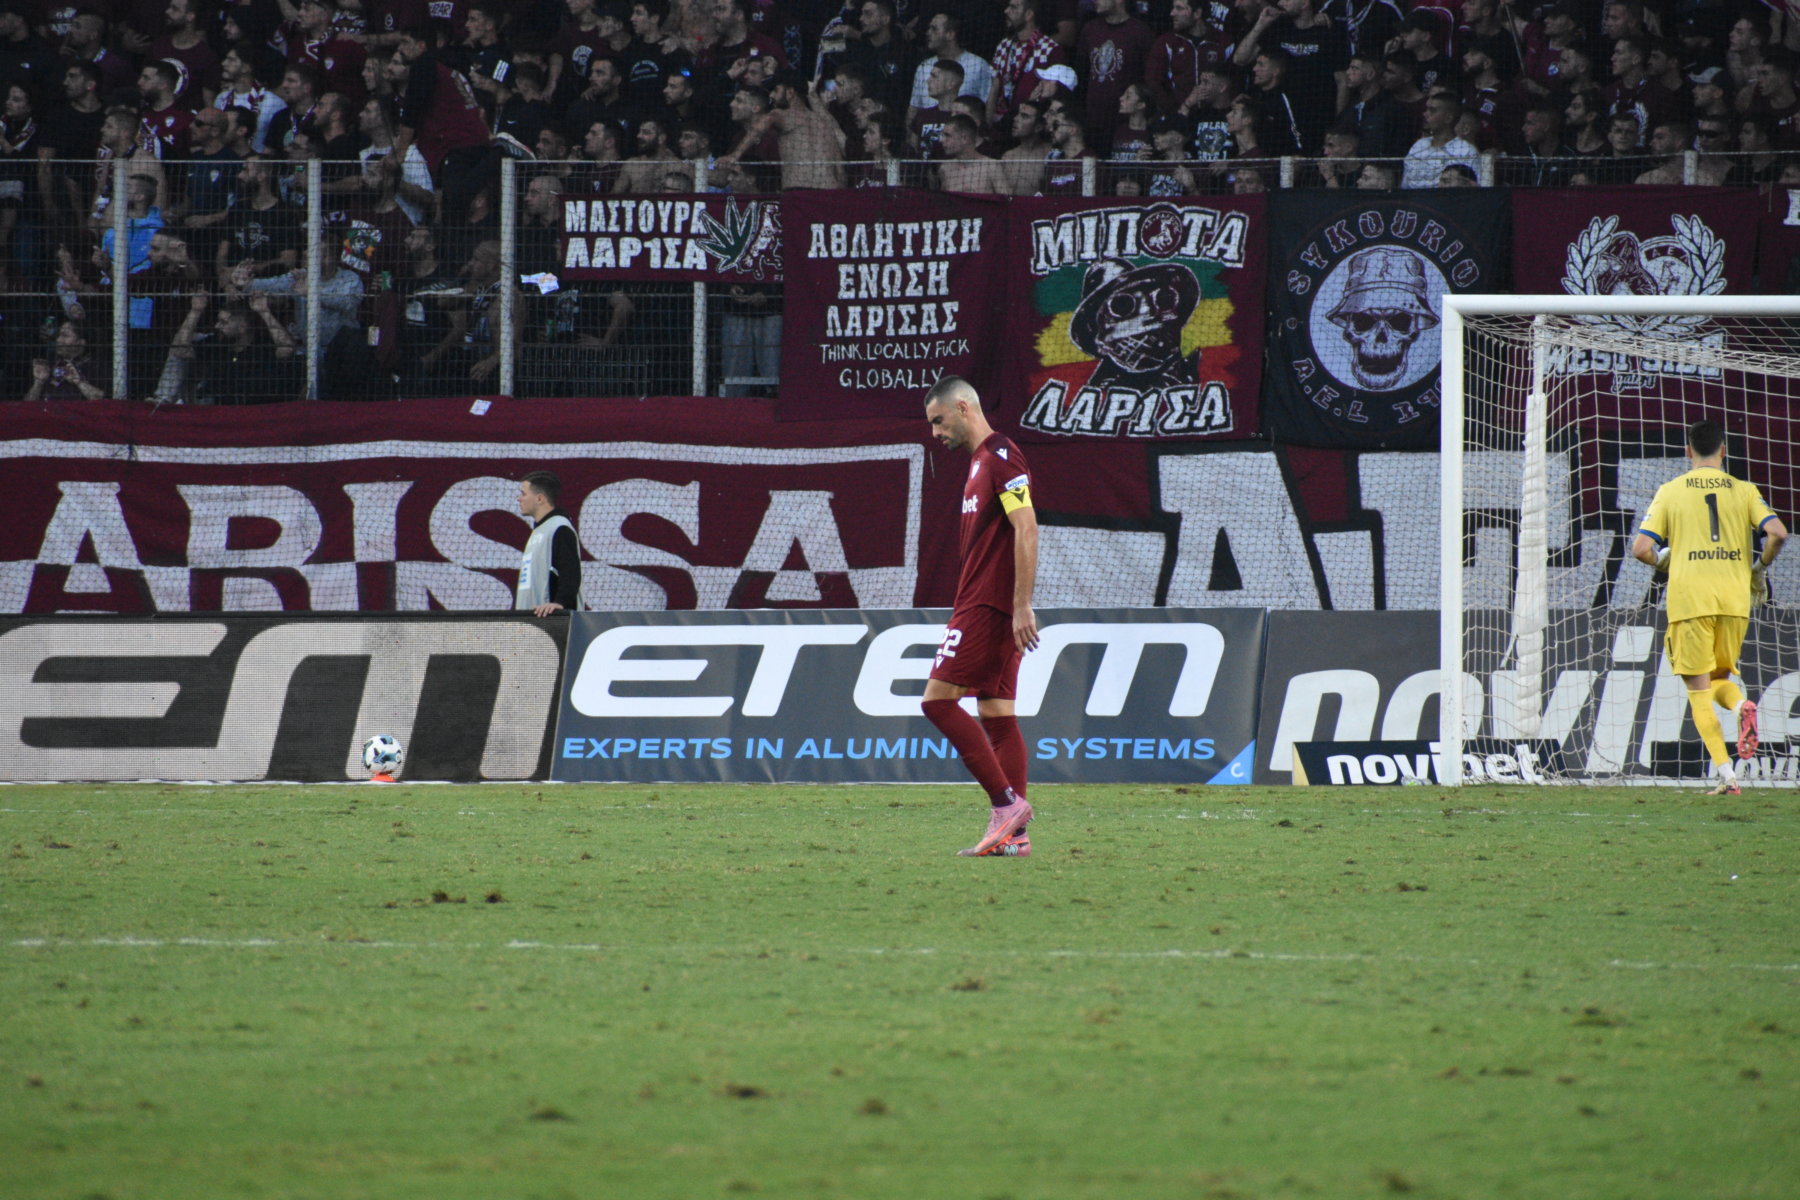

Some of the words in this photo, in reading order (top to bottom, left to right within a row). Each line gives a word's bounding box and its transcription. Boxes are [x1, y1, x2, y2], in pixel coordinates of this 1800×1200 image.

[564, 237, 708, 270] ΛΑΡΙΣΑ
[807, 218, 983, 258] ΑΘΛΗΤΙΚΗ
[1288, 210, 1480, 294] SYKOURIO
[837, 261, 949, 299] ΕΝΩΣΗ
[826, 301, 959, 337] ΛΑΡΙΣΑΣ
[839, 367, 944, 389] GLOBALLY
[1686, 477, 1733, 489] MELISSAS
[1704, 493, 1720, 542] 1
[1688, 547, 1741, 561] novibet
[562, 738, 732, 760] EXPERTS
[745, 738, 784, 760] IN
[1036, 737, 1216, 760] SYSTEMS
